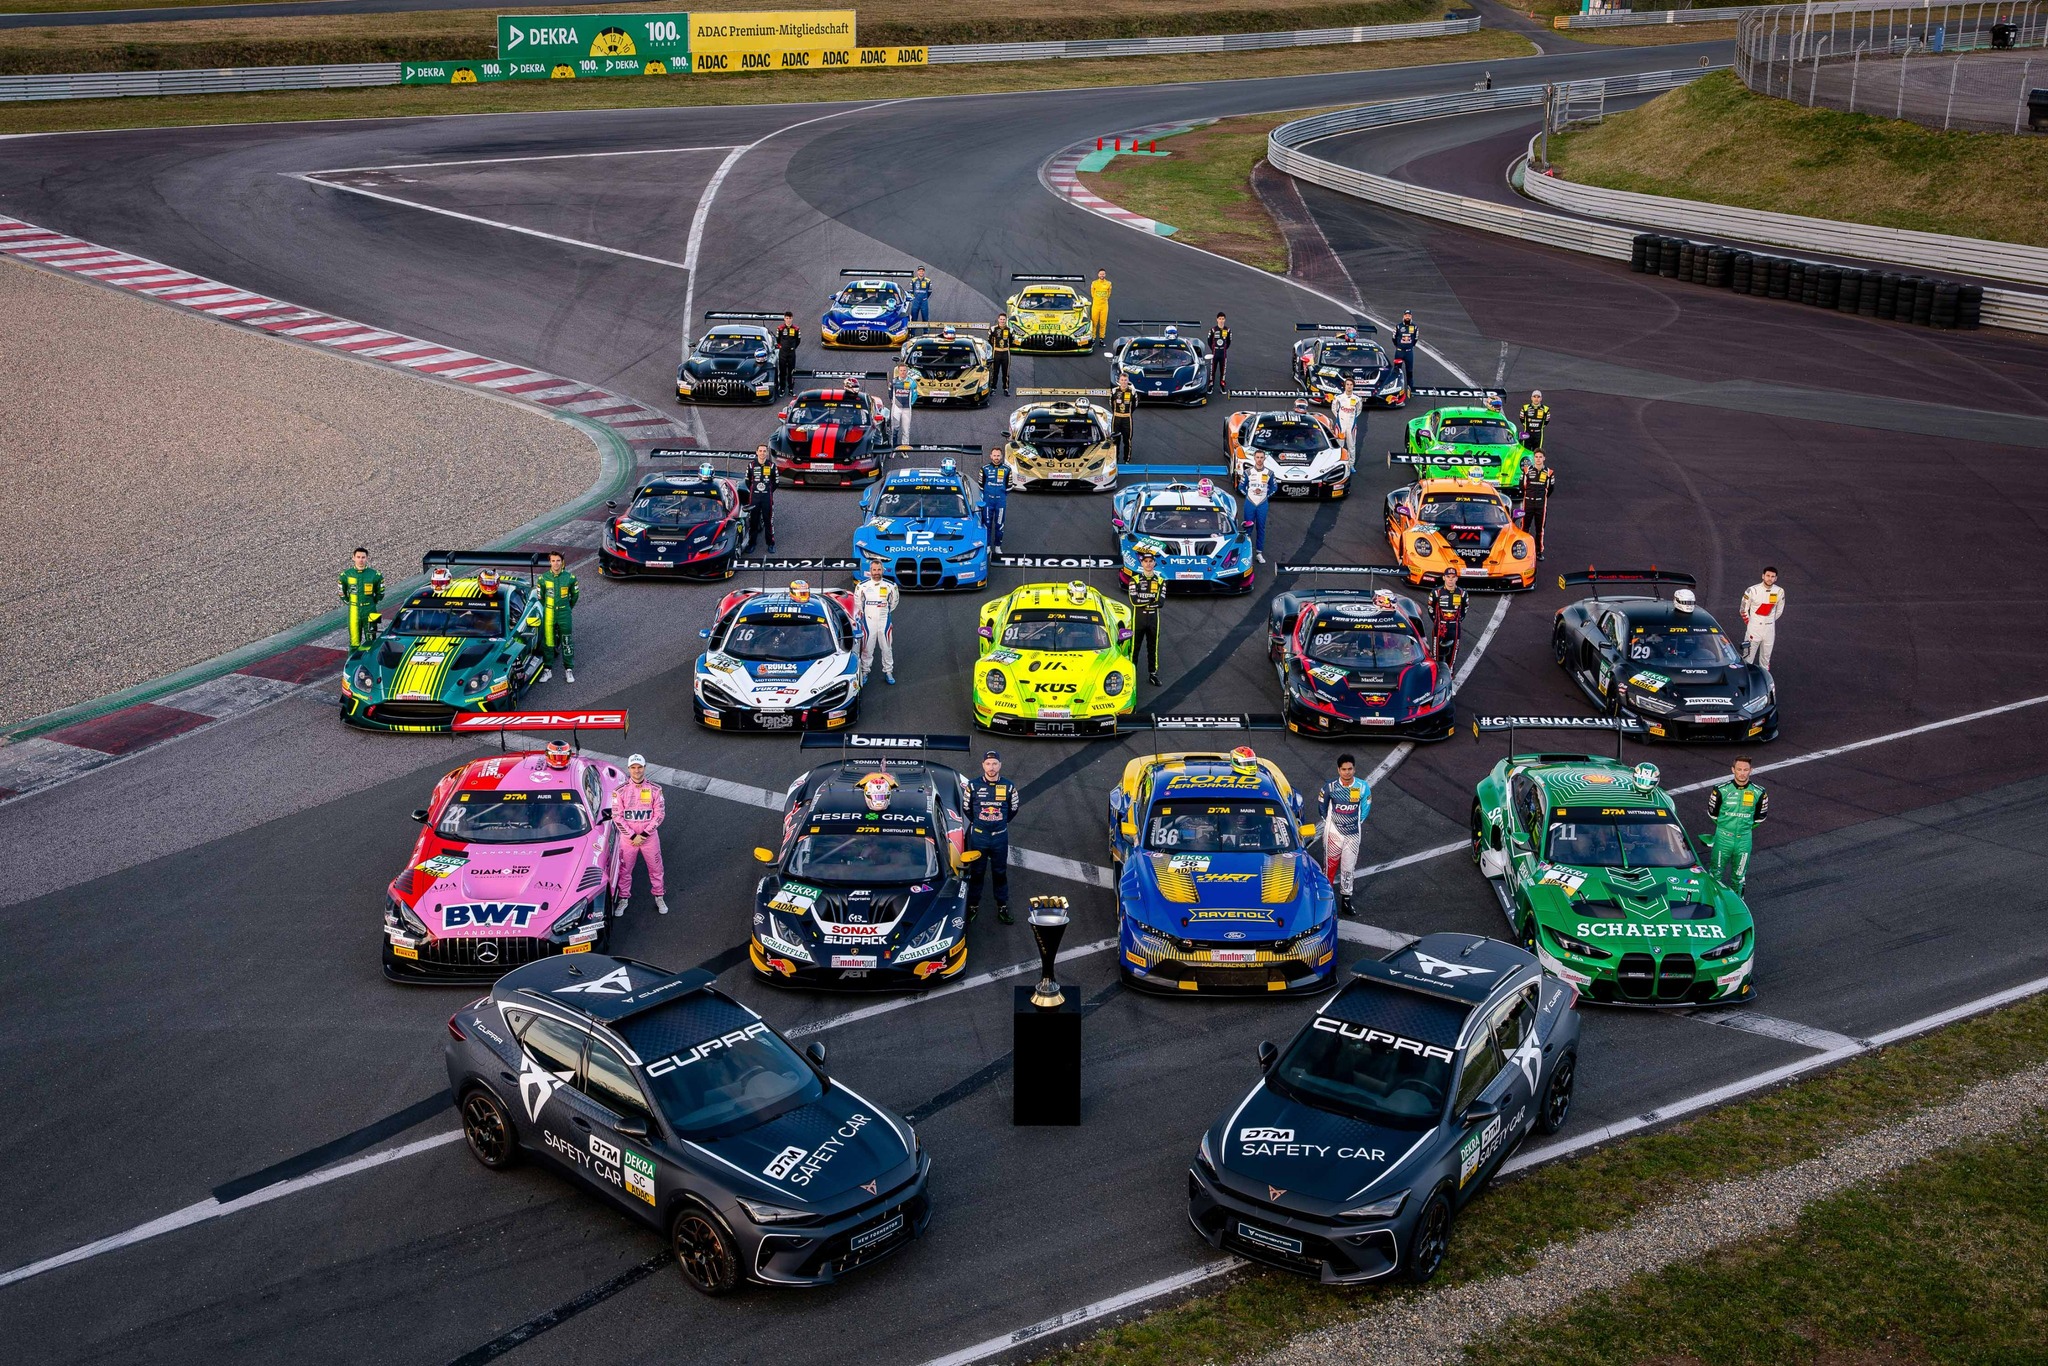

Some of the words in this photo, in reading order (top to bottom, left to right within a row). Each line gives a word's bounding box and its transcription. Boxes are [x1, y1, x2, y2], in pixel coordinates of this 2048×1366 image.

[530, 27, 578, 45] DEKRA
[649, 21, 676, 41] 100
[697, 26, 727, 37] ADAC
[730, 23, 849, 38] Premium-Mitgliedschaft
[672, 57, 687, 66] 100
[697, 55, 728, 69] ADAC
[742, 53, 771, 68] ADAC
[782, 52, 809, 66] ADAC
[822, 51, 849, 65] ADAC
[860, 50, 886, 64] ADAC
[898, 49, 923, 63] ADAC
[483, 64, 499, 74] 100
[521, 64, 545, 73] DEKRA
[581, 60, 596, 70] 100
[616, 60, 639, 69] DEKRA
[418, 68, 445, 77] DEKRA
[1444, 426, 1456, 435] 90
[1397, 456, 1492, 464] TRICORP
[636, 499, 650, 508] 10
[886, 495, 900, 504] 33
[1424, 504, 1437, 514] 92
[1144, 511, 1156, 520] 71
[732, 560, 857, 569] Handy24.de
[1001, 557, 1114, 568] TRICORP
[1284, 566, 1400, 574] VERSTAPPEN.COM
[736, 629, 755, 641] 16
[1004, 627, 1019, 641] 91
[1315, 633, 1332, 645] 69
[1633, 646, 1650, 659] 29
[1641, 670, 1669, 682] DEKRA
[1035, 683, 1077, 693] KÜS
[1634, 680, 1653, 690] ADAC
[994, 700, 1017, 709] VELTINS
[520, 715, 622, 724] AMG
[1480, 716, 1640, 728] #GREENMACHINE
[1169, 775, 1262, 784] FORD
[625, 810, 652, 820] BWT
[812, 813, 862, 821] FESER
[882, 814, 925, 823] GRAF
[1602, 808, 1626, 816] DTM
[1156, 828, 1178, 845] 36
[1558, 824, 1578, 840] 11
[433, 855, 466, 866] DEKRA
[1552, 863, 1590, 879] DEKRA
[783, 883, 818, 899] DEKRA
[1672, 885, 1700, 894] Motorsport
[787, 896, 797, 904] 1
[775, 902, 799, 913] ADAC
[445, 904, 536, 927] BWT
[832, 926, 879, 934] SONAX
[1576, 923, 1726, 938] SCHAEFFLER
[396, 948, 416, 957] PIRELLI
[763, 937, 809, 959] SCHAEFFLER
[899, 940, 950, 961] SCHAEFFLER
[840, 959, 876, 968] motorsport
[839, 970, 870, 979] ABT
[1403, 973, 1455, 989] CUPRA
[639, 980, 683, 999] CUPRA
[1549, 988, 1563, 1008] CUPRA
[478, 1024, 503, 1044] CUPRA
[1312, 1017, 1454, 1064] CUPRA
[645, 1021, 771, 1079] CUPRA
[1245, 1130, 1290, 1140] DTM
[1479, 1124, 1510, 1168] SAFETY
[1509, 1105, 1526, 1132] CAR
[593, 1140, 618, 1164] DTM
[791, 1136, 845, 1187] SAFETY
[838, 1113, 872, 1138] CAR
[1242, 1143, 1331, 1157] SAFETY
[1337, 1147, 1385, 1162] CAR
[1460, 1136, 1480, 1161] DEKRA
[543, 1129, 591, 1168] SAFETY
[595, 1161, 623, 1187] CAR
[770, 1150, 801, 1177] DTM
[625, 1152, 654, 1178] DEKRA
[633, 1173, 646, 1188] SC
[631, 1185, 650, 1203] ADAC
